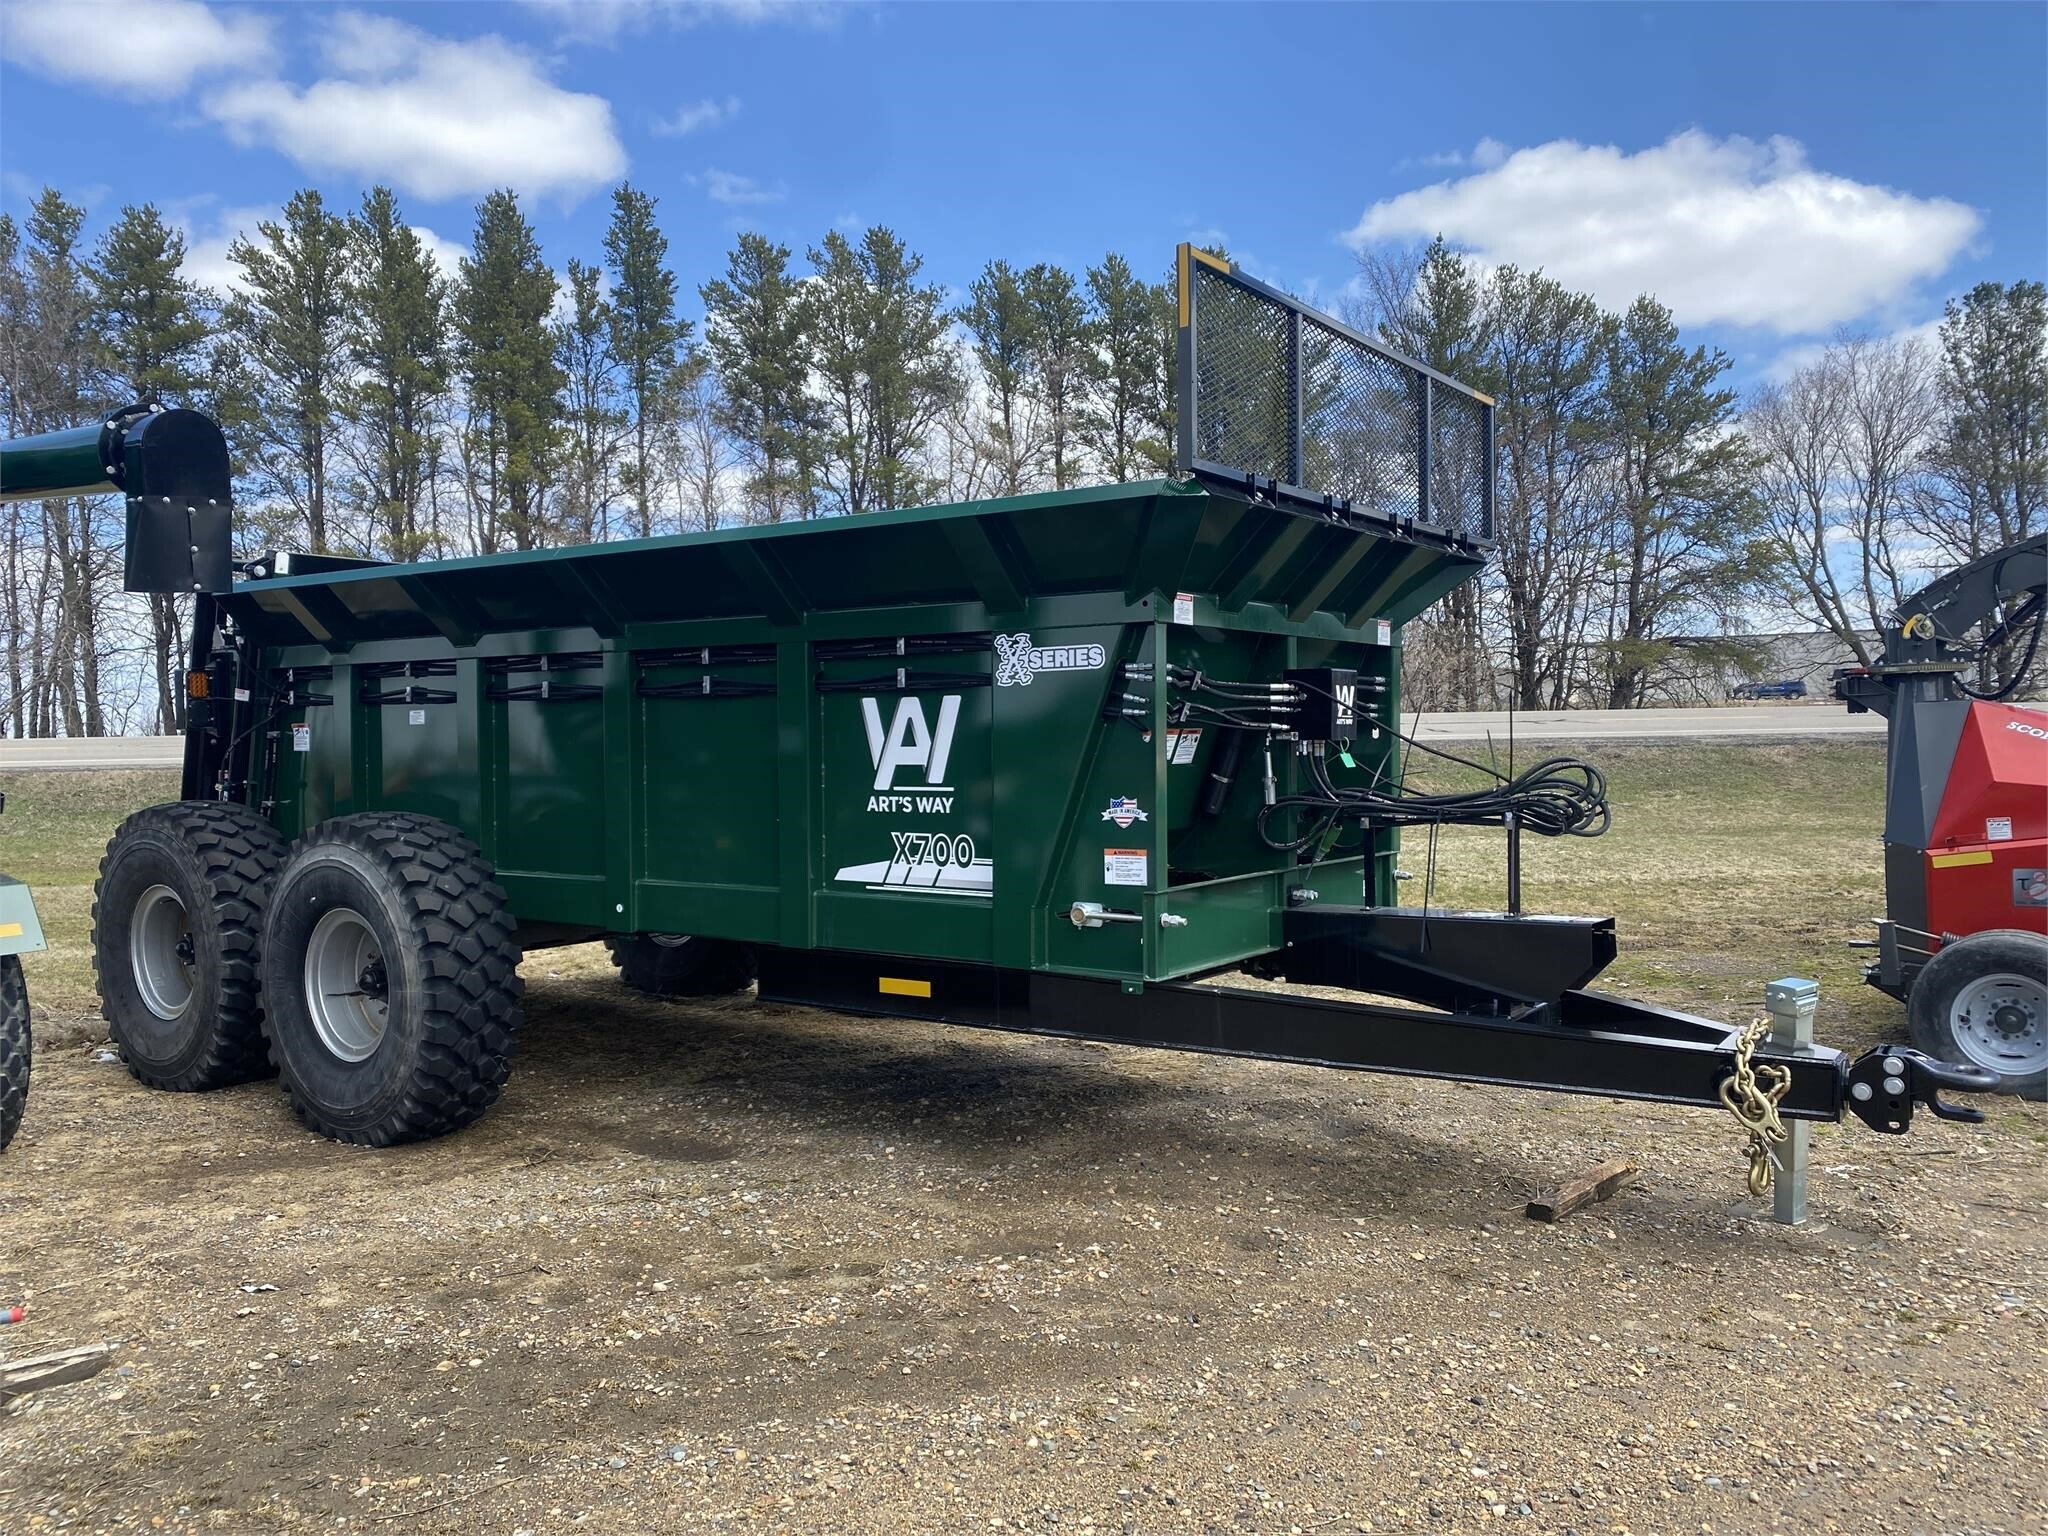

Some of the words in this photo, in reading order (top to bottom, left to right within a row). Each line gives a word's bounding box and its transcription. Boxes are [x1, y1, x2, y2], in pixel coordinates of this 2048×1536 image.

[1028, 645, 1104, 670] SERIES
[867, 796, 913, 813] ART'S
[915, 797, 954, 814] WAY
[1124, 808, 1141, 816] AMERICA
[891, 832, 975, 869] X700
